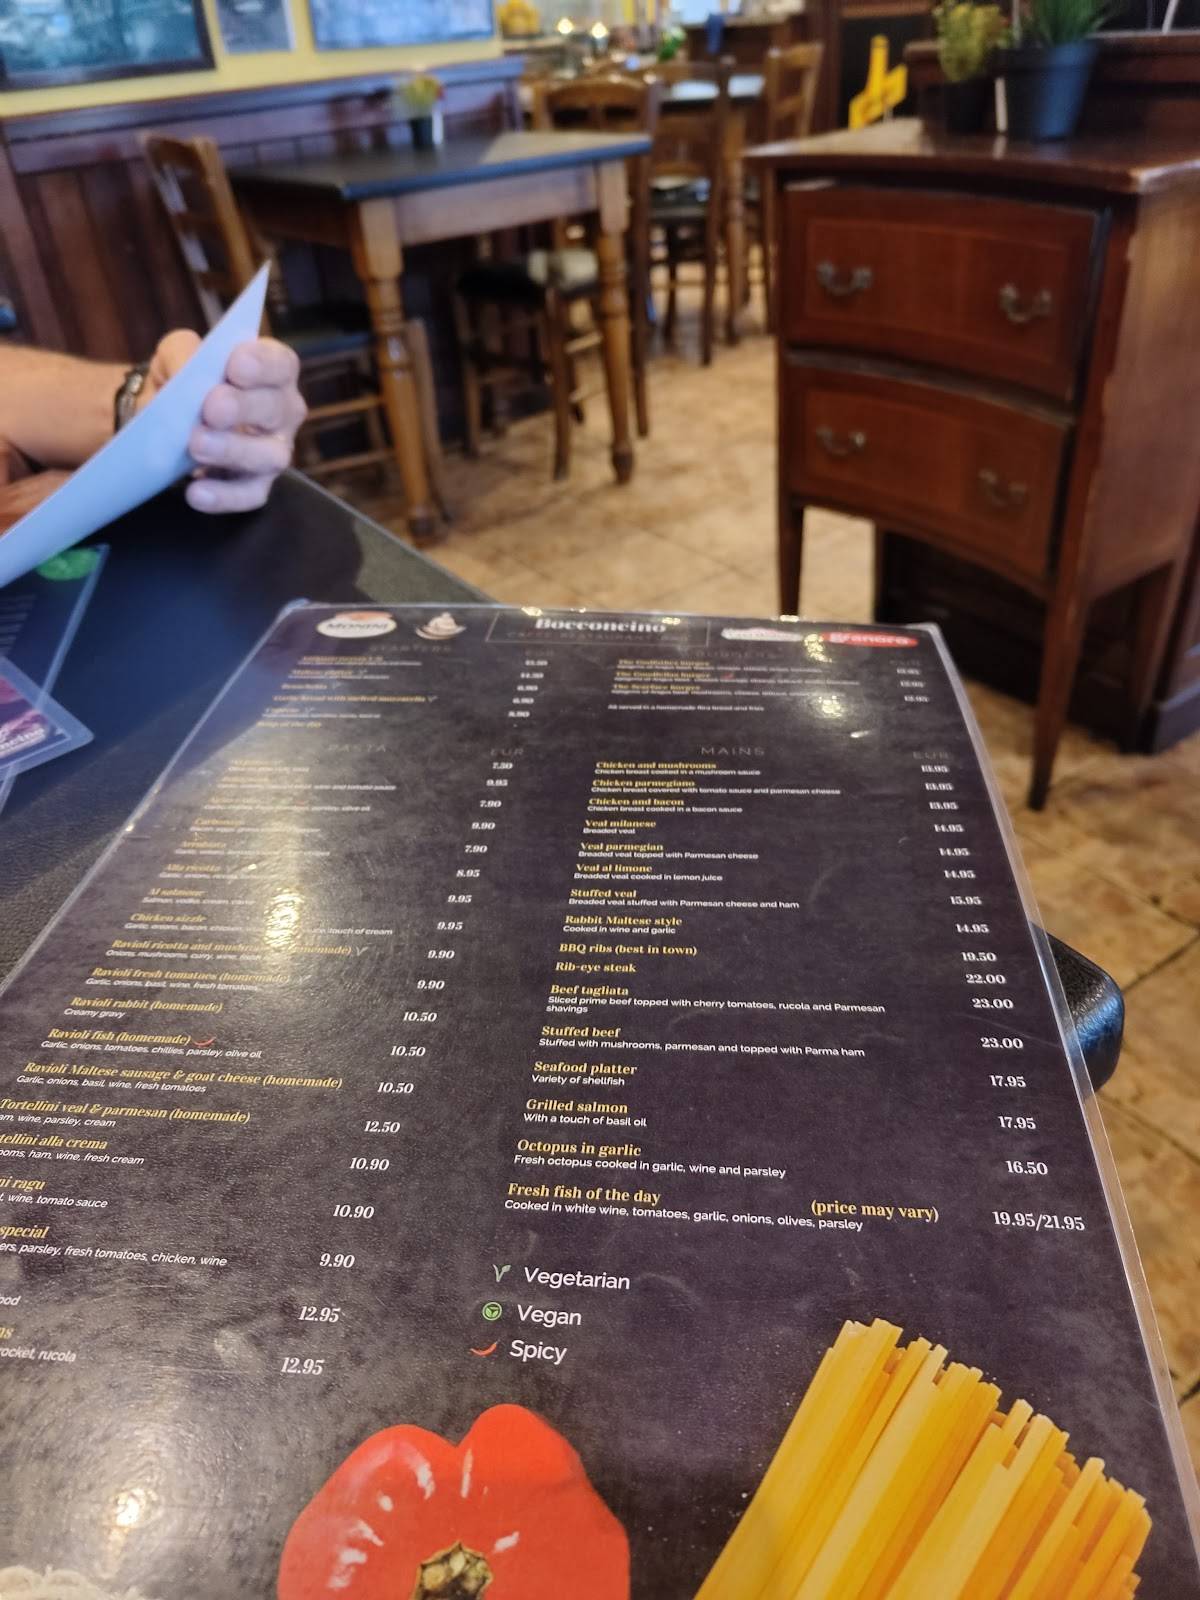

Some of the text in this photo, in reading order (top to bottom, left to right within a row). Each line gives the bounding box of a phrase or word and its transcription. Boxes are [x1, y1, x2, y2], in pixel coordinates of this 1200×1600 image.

[701, 746, 764, 755] MAINS
[596, 761, 635, 769] Chicken
[580, 842, 603, 852] Veal
[456, 869, 479, 877] 8.95
[447, 894, 471, 903] 9.95
[570, 889, 611, 897] Stuffed
[950, 895, 981, 904] 15.95
[436, 921, 462, 930] 9.95
[565, 915, 682, 928] Rabbit Maltese style
[956, 923, 989, 932] 14.95
[427, 949, 454, 958] 9.90
[559, 943, 697, 955] BBQ ribs (best in town)
[962, 951, 996, 961] 19.50
[555, 961, 635, 973] Rib-eye steak
[416, 979, 444, 989] 9.90
[965, 973, 1005, 983] 22.00
[550, 984, 628, 996] Beef tagliata
[70, 997, 222, 1013] Ravioli rabbit (homemade)
[546, 1005, 587, 1013] shavings
[548, 995, 577, 1004] Sliced
[578, 997, 607, 1005] prime
[608, 997, 632, 1005] beef
[633, 998, 668, 1006] topped
[693, 999, 724, 1008] cherry
[778, 1002, 810, 1010] rucola
[812, 1003, 832, 1011] and
[834, 1003, 884, 1012] Parmesan
[972, 998, 1013, 1008] 23.00
[63, 1007, 125, 1018] Creamy gravy
[403, 1011, 437, 1021] 10.50
[47, 1028, 191, 1047] Ravioli fish (homemade)
[541, 1026, 620, 1037] Stuffed beef
[538, 1038, 575, 1046] Stuffed
[577, 1039, 598, 1047] with
[664, 1043, 715, 1051] parmesan
[718, 1044, 737, 1052] and
[740, 1044, 777, 1054] topped
[780, 1046, 802, 1054] with
[804, 1046, 839, 1055] Parma
[840, 1047, 864, 1056] ham
[980, 1037, 1023, 1048] 23.00
[390, 1045, 425, 1056] 10.50
[534, 1061, 636, 1076] Seafood platter
[23, 1062, 342, 1088] Ravioli Maltese sausage & goat cheese (homemade)
[531, 1074, 624, 1085] Variety of shellfish
[990, 1075, 1025, 1087] 17.95
[377, 1082, 413, 1093] 10.50
[0, 1098, 250, 1123] Tortellini veal & parmesan (homemade)
[526, 1098, 627, 1113] Grilled salmon
[83, 1115, 116, 1126] cream
[523, 1112, 547, 1122] With
[559, 1115, 589, 1123] touch
[592, 1115, 604, 1124] of
[605, 1116, 630, 1125] basil
[633, 1117, 646, 1126] oil
[999, 1116, 1035, 1129] 17.95
[364, 1120, 400, 1132] 12.50
[38, 1135, 107, 1149] alla crema
[517, 1139, 640, 1157] Octopus in garlic
[83, 1152, 110, 1162] fresh
[111, 1156, 144, 1164] cream
[350, 1157, 389, 1170] 10.90
[514, 1154, 544, 1164] Fresh
[547, 1154, 592, 1167] octopus
[594, 1159, 636, 1169] cooked
[639, 1160, 649, 1170] in
[688, 1163, 716, 1173] wine
[718, 1165, 740, 1174] and
[743, 1167, 785, 1178] parsley
[1006, 1160, 1047, 1174] 16.50
[11, 1179, 45, 1194] ragu
[508, 1182, 660, 1206] Fresh fish of the day
[36, 1195, 74, 1205] tomato
[75, 1199, 107, 1207] sauce
[333, 1204, 374, 1218] 10.90
[504, 1199, 549, 1210] Cooked
[551, 1201, 561, 1212] in
[564, 1203, 596, 1213] white
[818, 1219, 862, 1231] parsley
[811, 1200, 938, 1222] (price may vary)
[994, 1211, 1084, 1230] 19.95/21.95
[64, 1245, 92, 1256] fresh
[200, 1255, 227, 1266] wine
[319, 1253, 354, 1267] 9.90
[525, 1267, 629, 1288] Vegetarian
[299, 1303, 340, 1322] 12.95
[517, 1304, 581, 1327] Vegan
[38, 1349, 79, 1365] rucola
[510, 1339, 566, 1364] Spicy
[281, 1357, 324, 1375] 12.95
